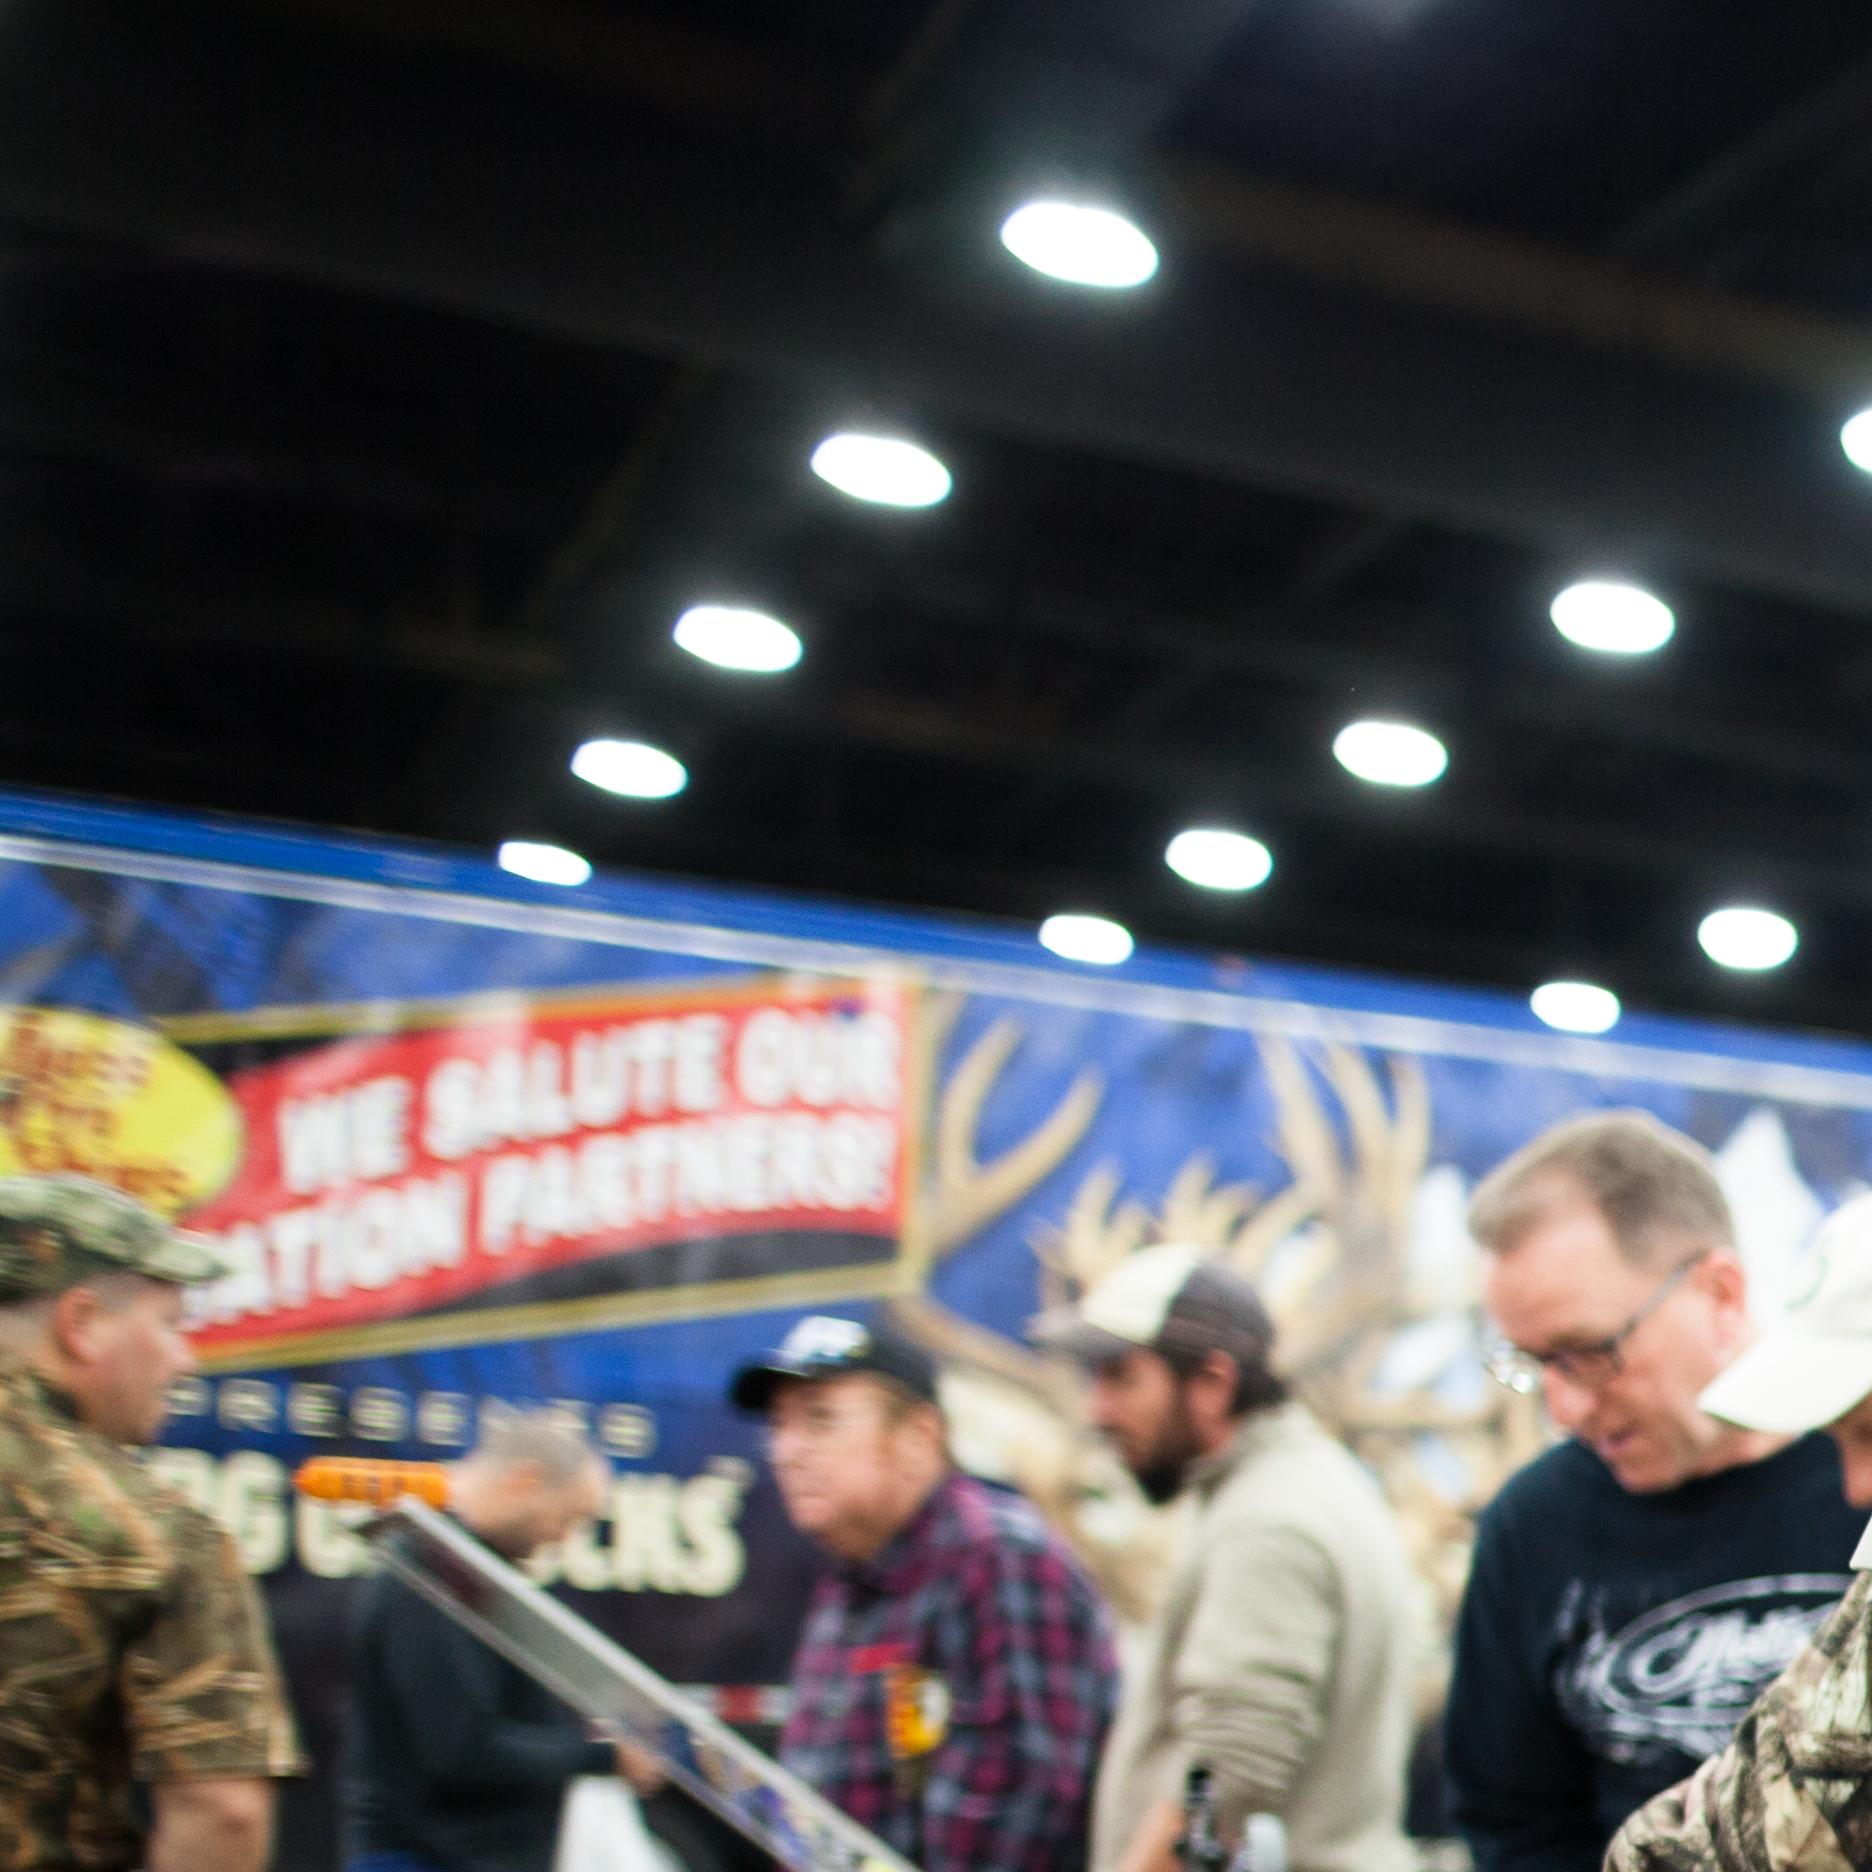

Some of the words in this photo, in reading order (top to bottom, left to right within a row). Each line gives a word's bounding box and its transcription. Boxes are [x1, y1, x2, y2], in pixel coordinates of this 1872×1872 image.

[276, 1075, 412, 1192] WE
[423, 1012, 728, 1160] SALUTE
[738, 1007, 896, 1110] OUR
